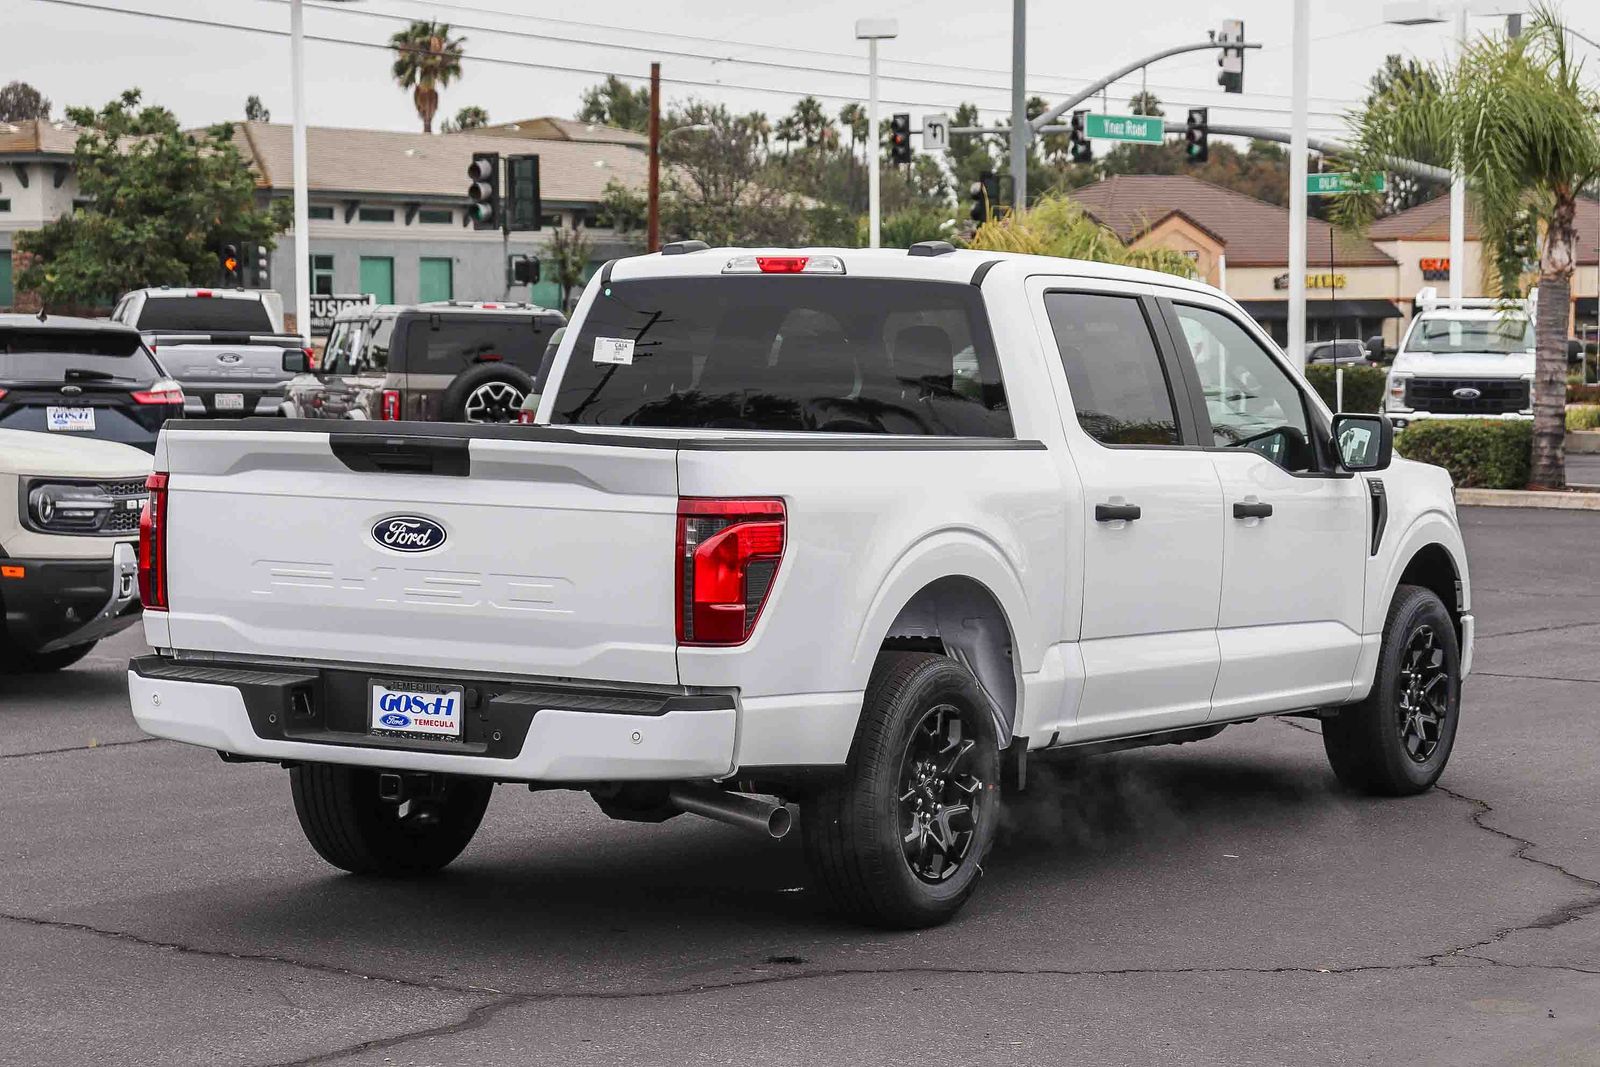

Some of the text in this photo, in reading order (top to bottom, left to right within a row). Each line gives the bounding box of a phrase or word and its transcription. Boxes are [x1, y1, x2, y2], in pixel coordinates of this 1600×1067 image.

[1103, 119, 1148, 137] Ynez Road
[384, 521, 432, 546] Ford
[391, 682, 441, 693] TEMECULA
[414, 718, 455, 728] TEMECULA
